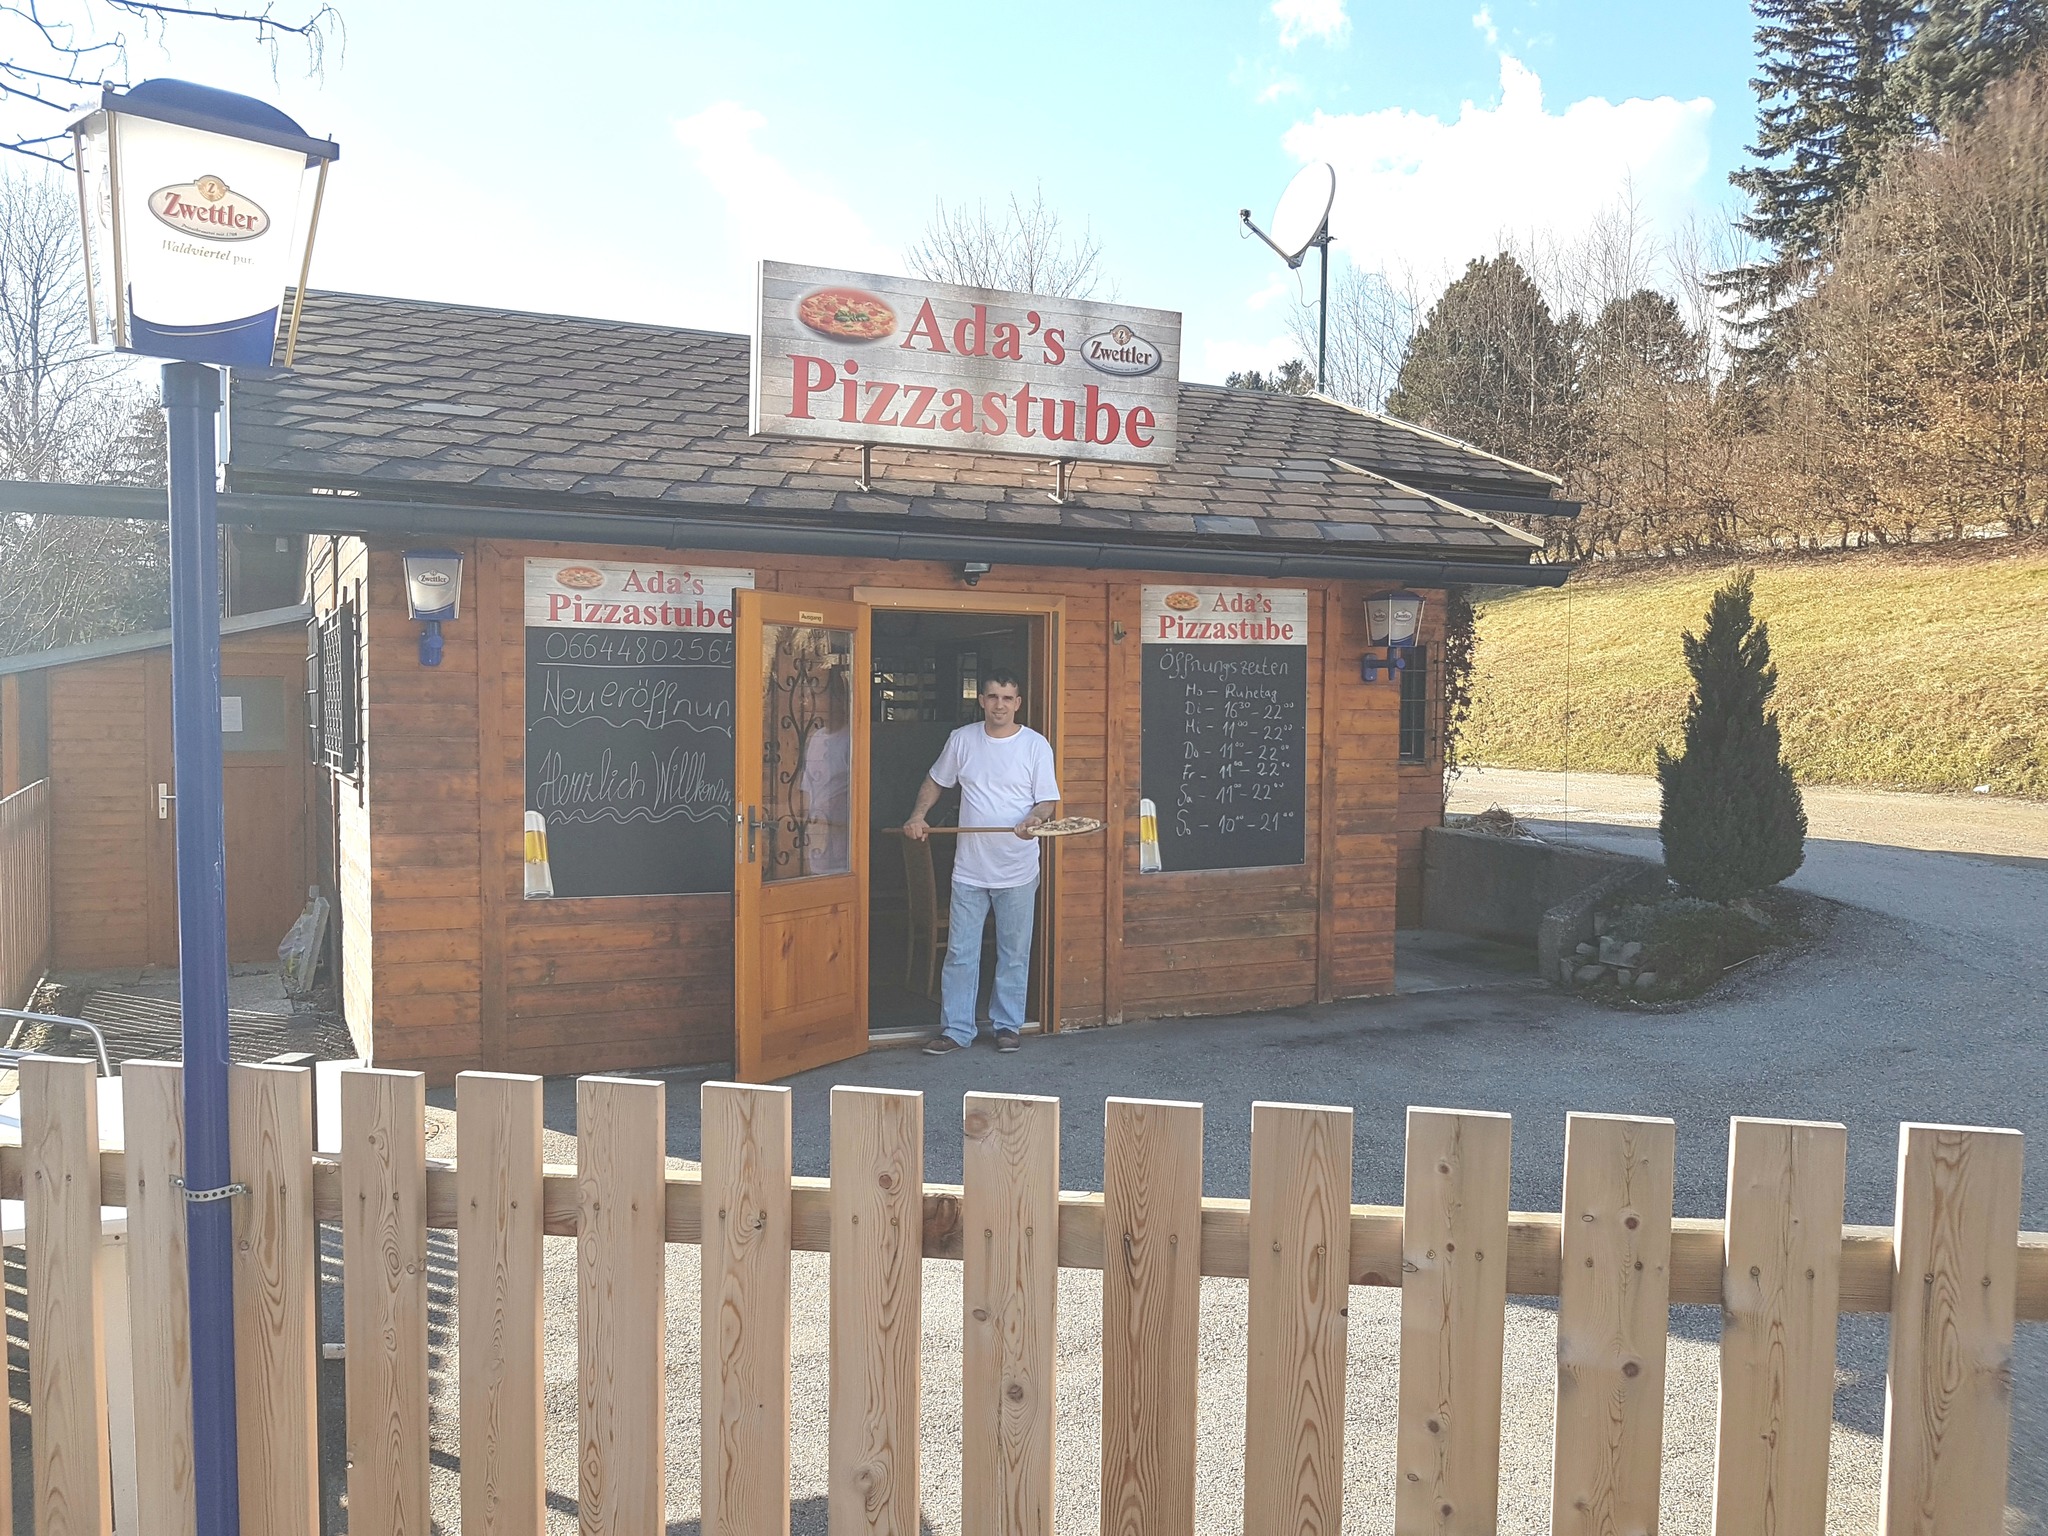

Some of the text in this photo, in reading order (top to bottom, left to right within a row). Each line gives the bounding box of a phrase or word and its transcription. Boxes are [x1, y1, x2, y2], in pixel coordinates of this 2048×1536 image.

[163, 191, 258, 232] Zwettler
[162, 239, 255, 266] Waldviertel pur.
[899, 297, 1065, 366] Ada's
[1090, 340, 1152, 366] Zwettler
[784, 353, 1156, 449] Pizzastube
[621, 569, 705, 596] Ada's
[546, 593, 733, 629] Pizzastube
[1212, 592, 1272, 613] Ada's
[1157, 615, 1294, 641] Pizzastube
[543, 670, 732, 731] Neueröffnun
[1225, 683, 1278, 703] Ruhetag
[1185, 701, 1202, 715] Di
[536, 748, 646, 810] Herzlich
